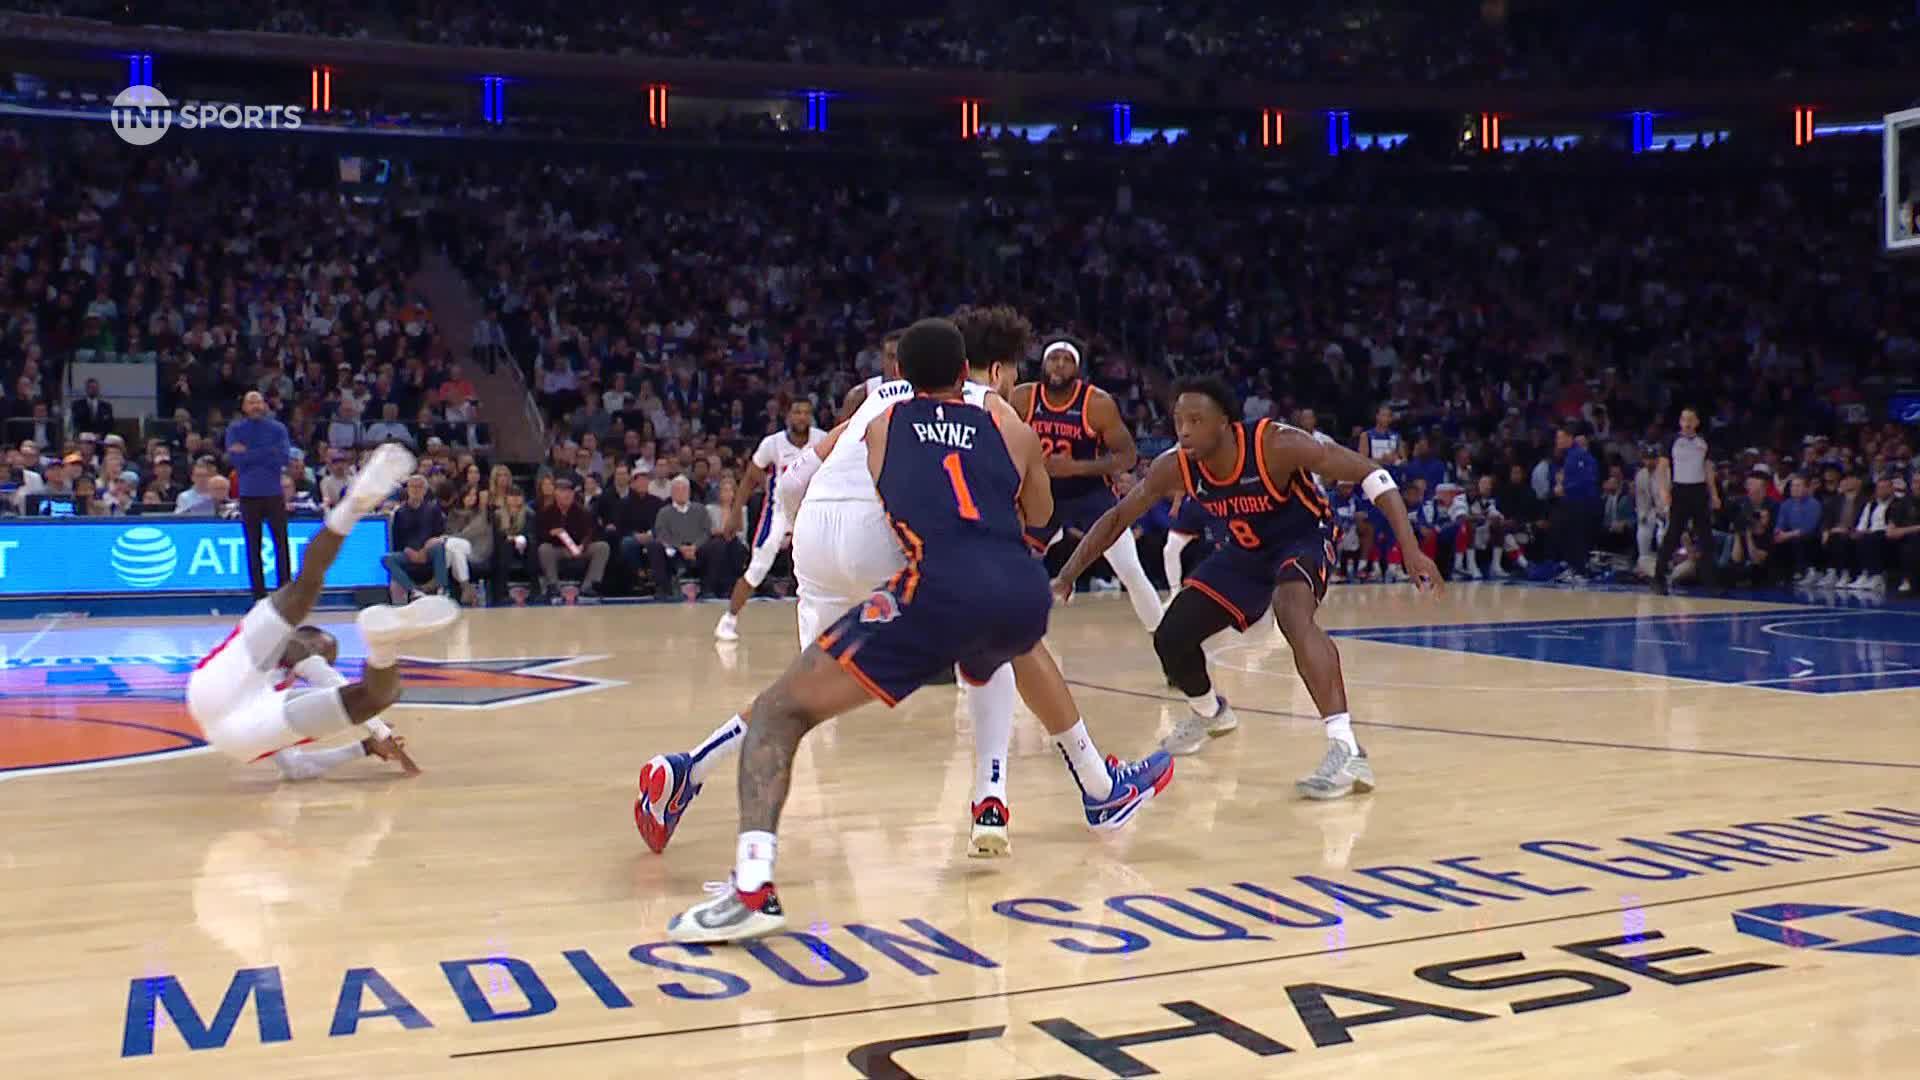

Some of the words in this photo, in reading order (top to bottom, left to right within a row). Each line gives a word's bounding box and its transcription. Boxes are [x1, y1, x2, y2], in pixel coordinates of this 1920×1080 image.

[912, 422, 977, 450] PAYNE
[1053, 423, 1082, 440] YORK
[943, 452, 981, 520] 1
[1228, 496, 1275, 514] YORK
[1229, 518, 1260, 549] 8
[120, 918, 1000, 1058] MADISON
[991, 855, 1594, 955] SQUARE
[847, 929, 1787, 1080] CHASE
